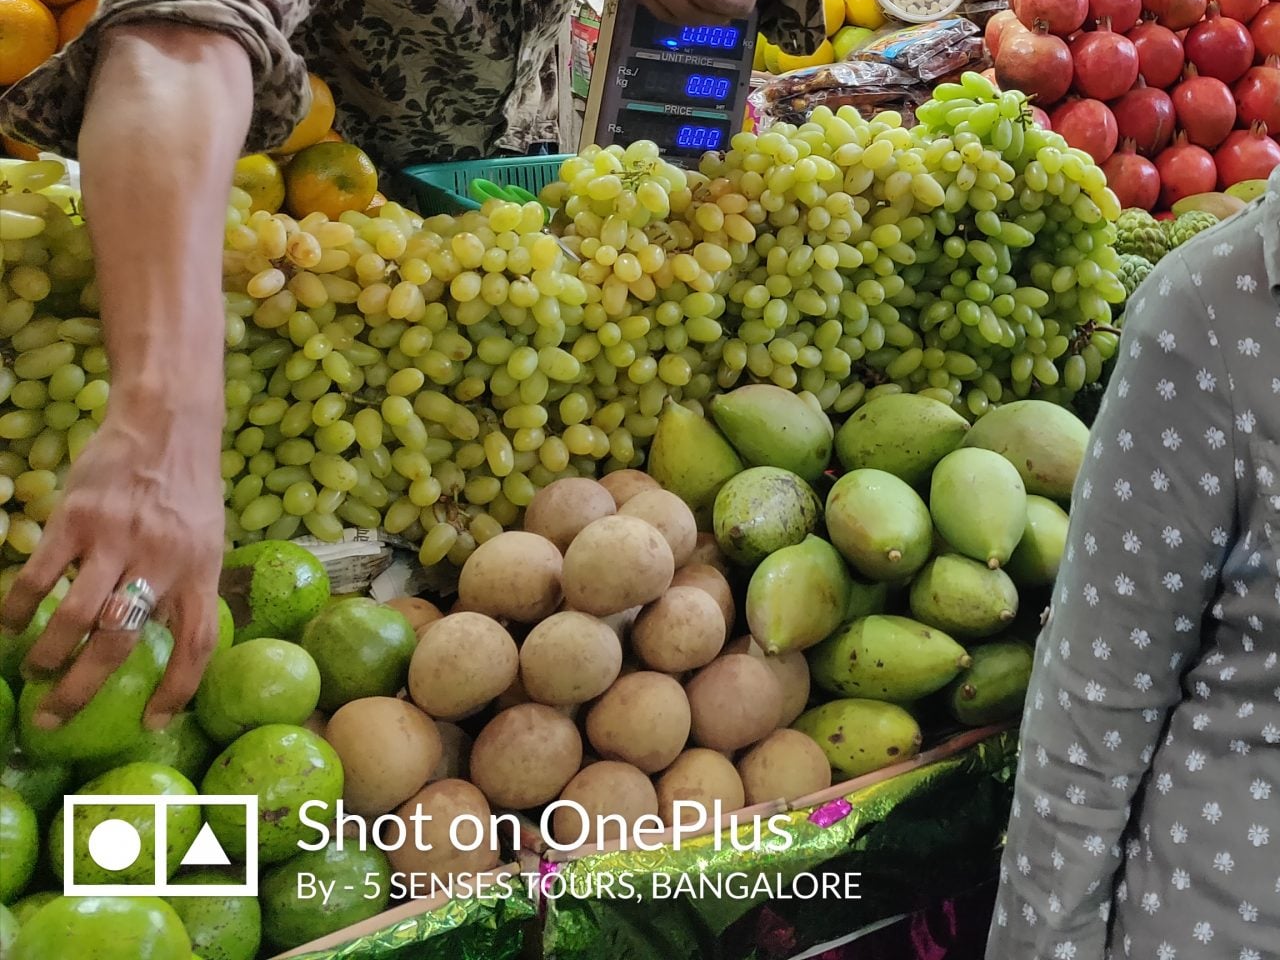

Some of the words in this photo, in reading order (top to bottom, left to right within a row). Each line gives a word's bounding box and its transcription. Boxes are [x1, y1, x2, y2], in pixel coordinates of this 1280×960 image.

[742, 38, 754, 49] kg
[661, 52, 685, 63] UNIT
[685, 55, 714, 67] PRICE
[617, 65, 639, 77] Rs./
[616, 76, 629, 88] kg
[687, 76, 729, 98] 0.00
[664, 104, 693, 116] PRICE
[607, 123, 625, 134] Rs.
[678, 127, 721, 148] 0.00
